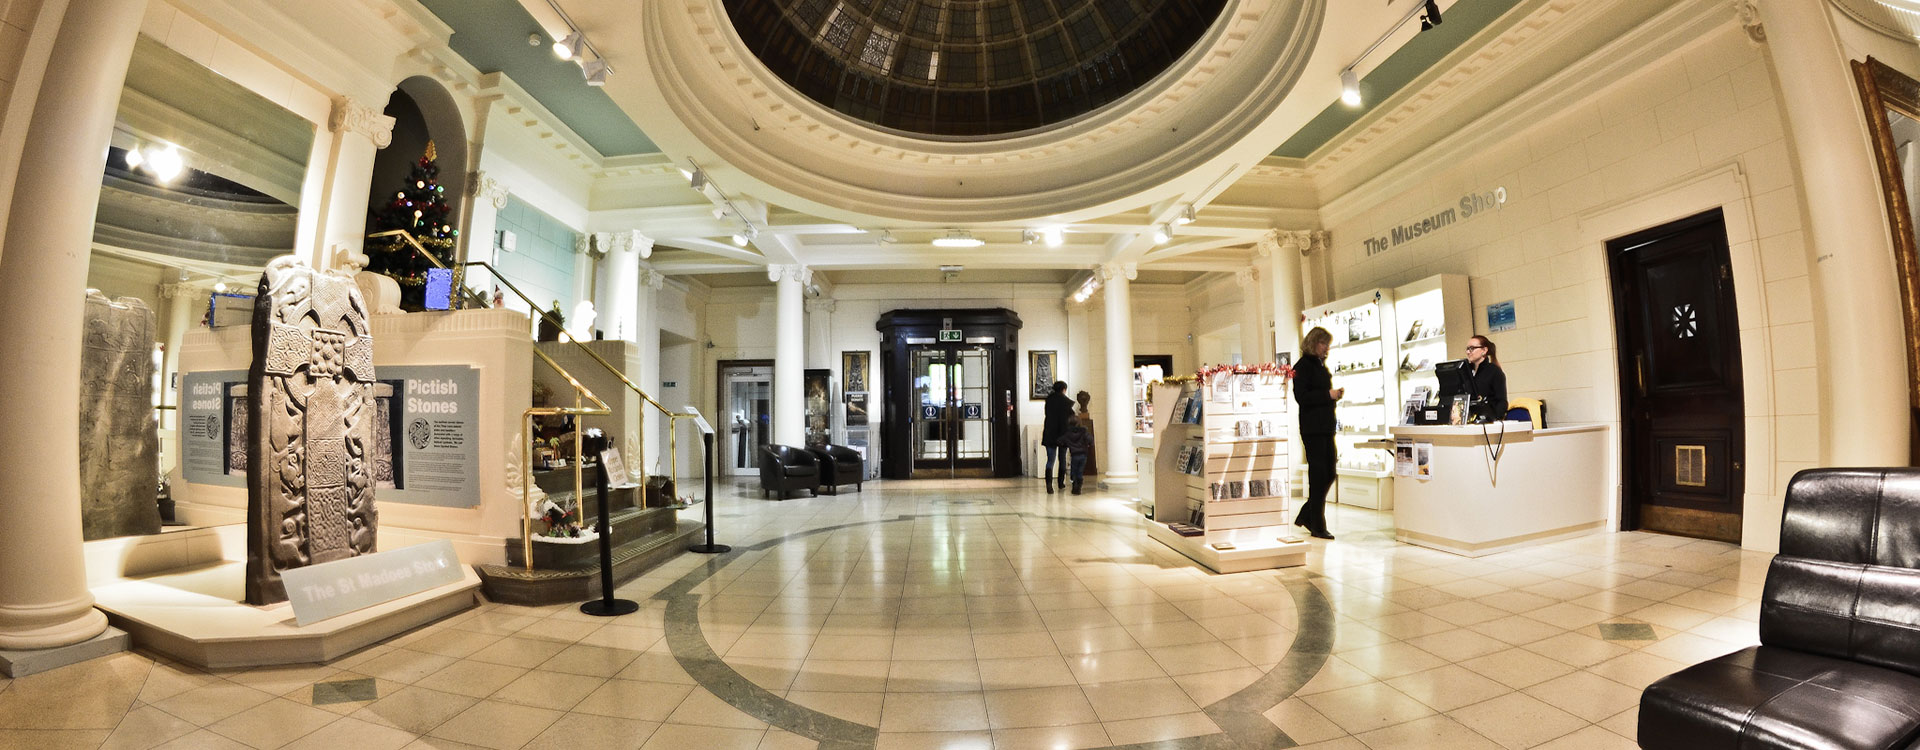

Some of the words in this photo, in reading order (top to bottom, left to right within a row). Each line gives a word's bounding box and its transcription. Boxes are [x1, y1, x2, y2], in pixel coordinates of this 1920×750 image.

[1364, 236, 1389, 257] The
[1391, 207, 1457, 246] Museum
[1459, 186, 1507, 218] Shop
[408, 379, 458, 395] Pictish
[408, 397, 458, 414] Stones
[303, 585, 336, 602] The
[337, 576, 357, 595] St
[358, 567, 412, 588] Madoes
